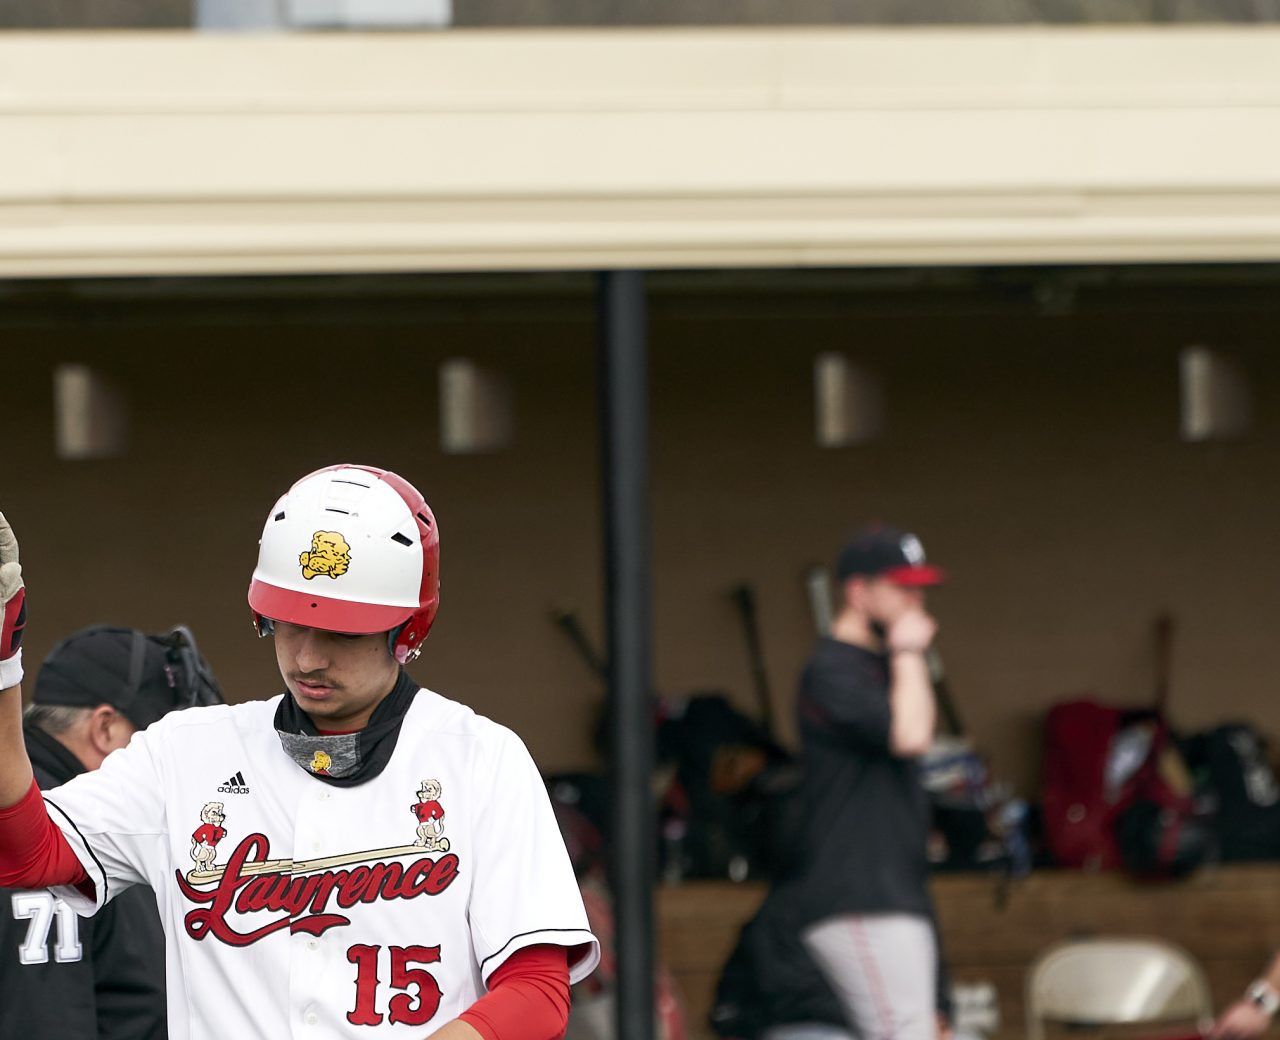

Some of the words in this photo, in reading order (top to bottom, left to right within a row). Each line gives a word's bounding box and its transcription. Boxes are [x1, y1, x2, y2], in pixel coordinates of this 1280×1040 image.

[217, 785, 250, 795] adidas
[11, 890, 83, 965] 71
[175, 833, 460, 948] Lawrence
[346, 944, 444, 1026] 15
